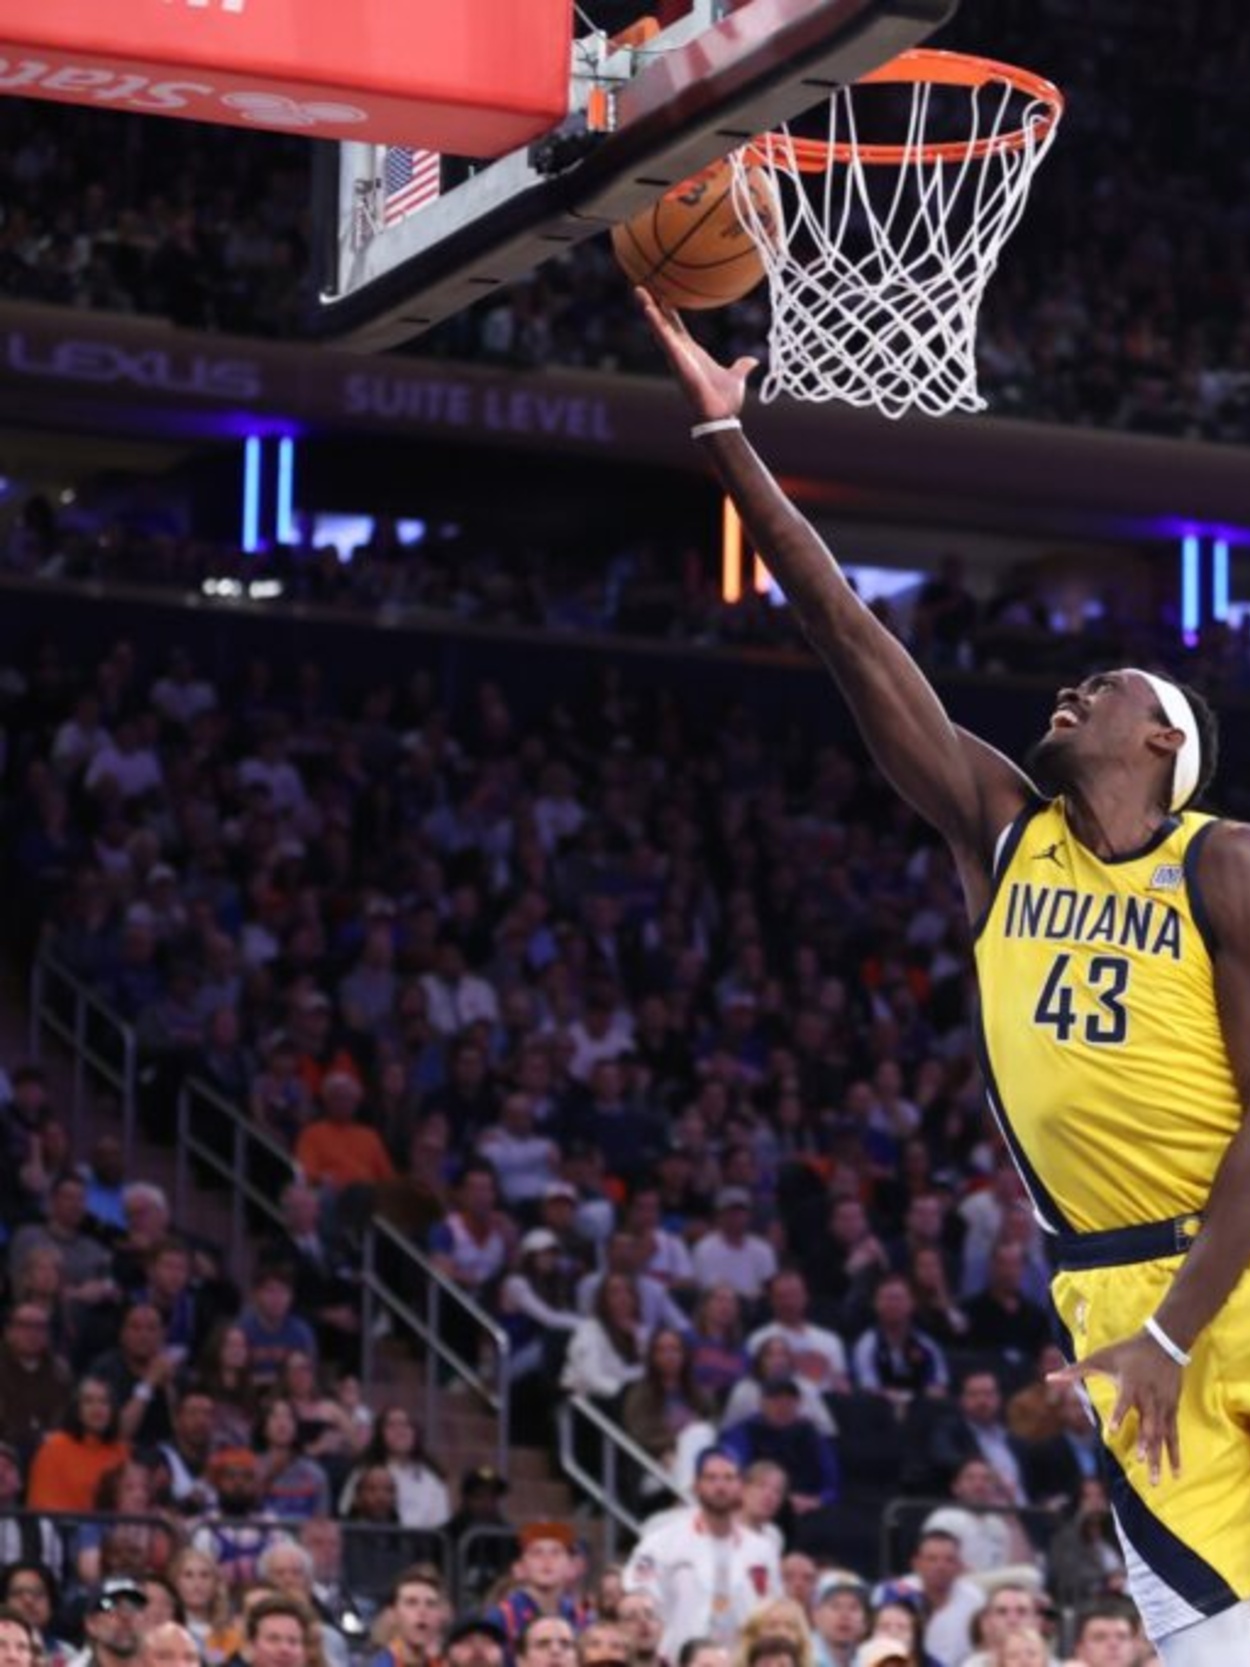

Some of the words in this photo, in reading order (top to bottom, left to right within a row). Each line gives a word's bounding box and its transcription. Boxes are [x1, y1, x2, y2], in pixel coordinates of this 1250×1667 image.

[0, 58, 214, 108] Stat
[8, 332, 261, 398] LEXUS
[345, 373, 471, 422] SUITE
[485, 384, 613, 441] LEVEL
[1004, 883, 1181, 961] INDIANA
[1034, 954, 1130, 1044] 43
